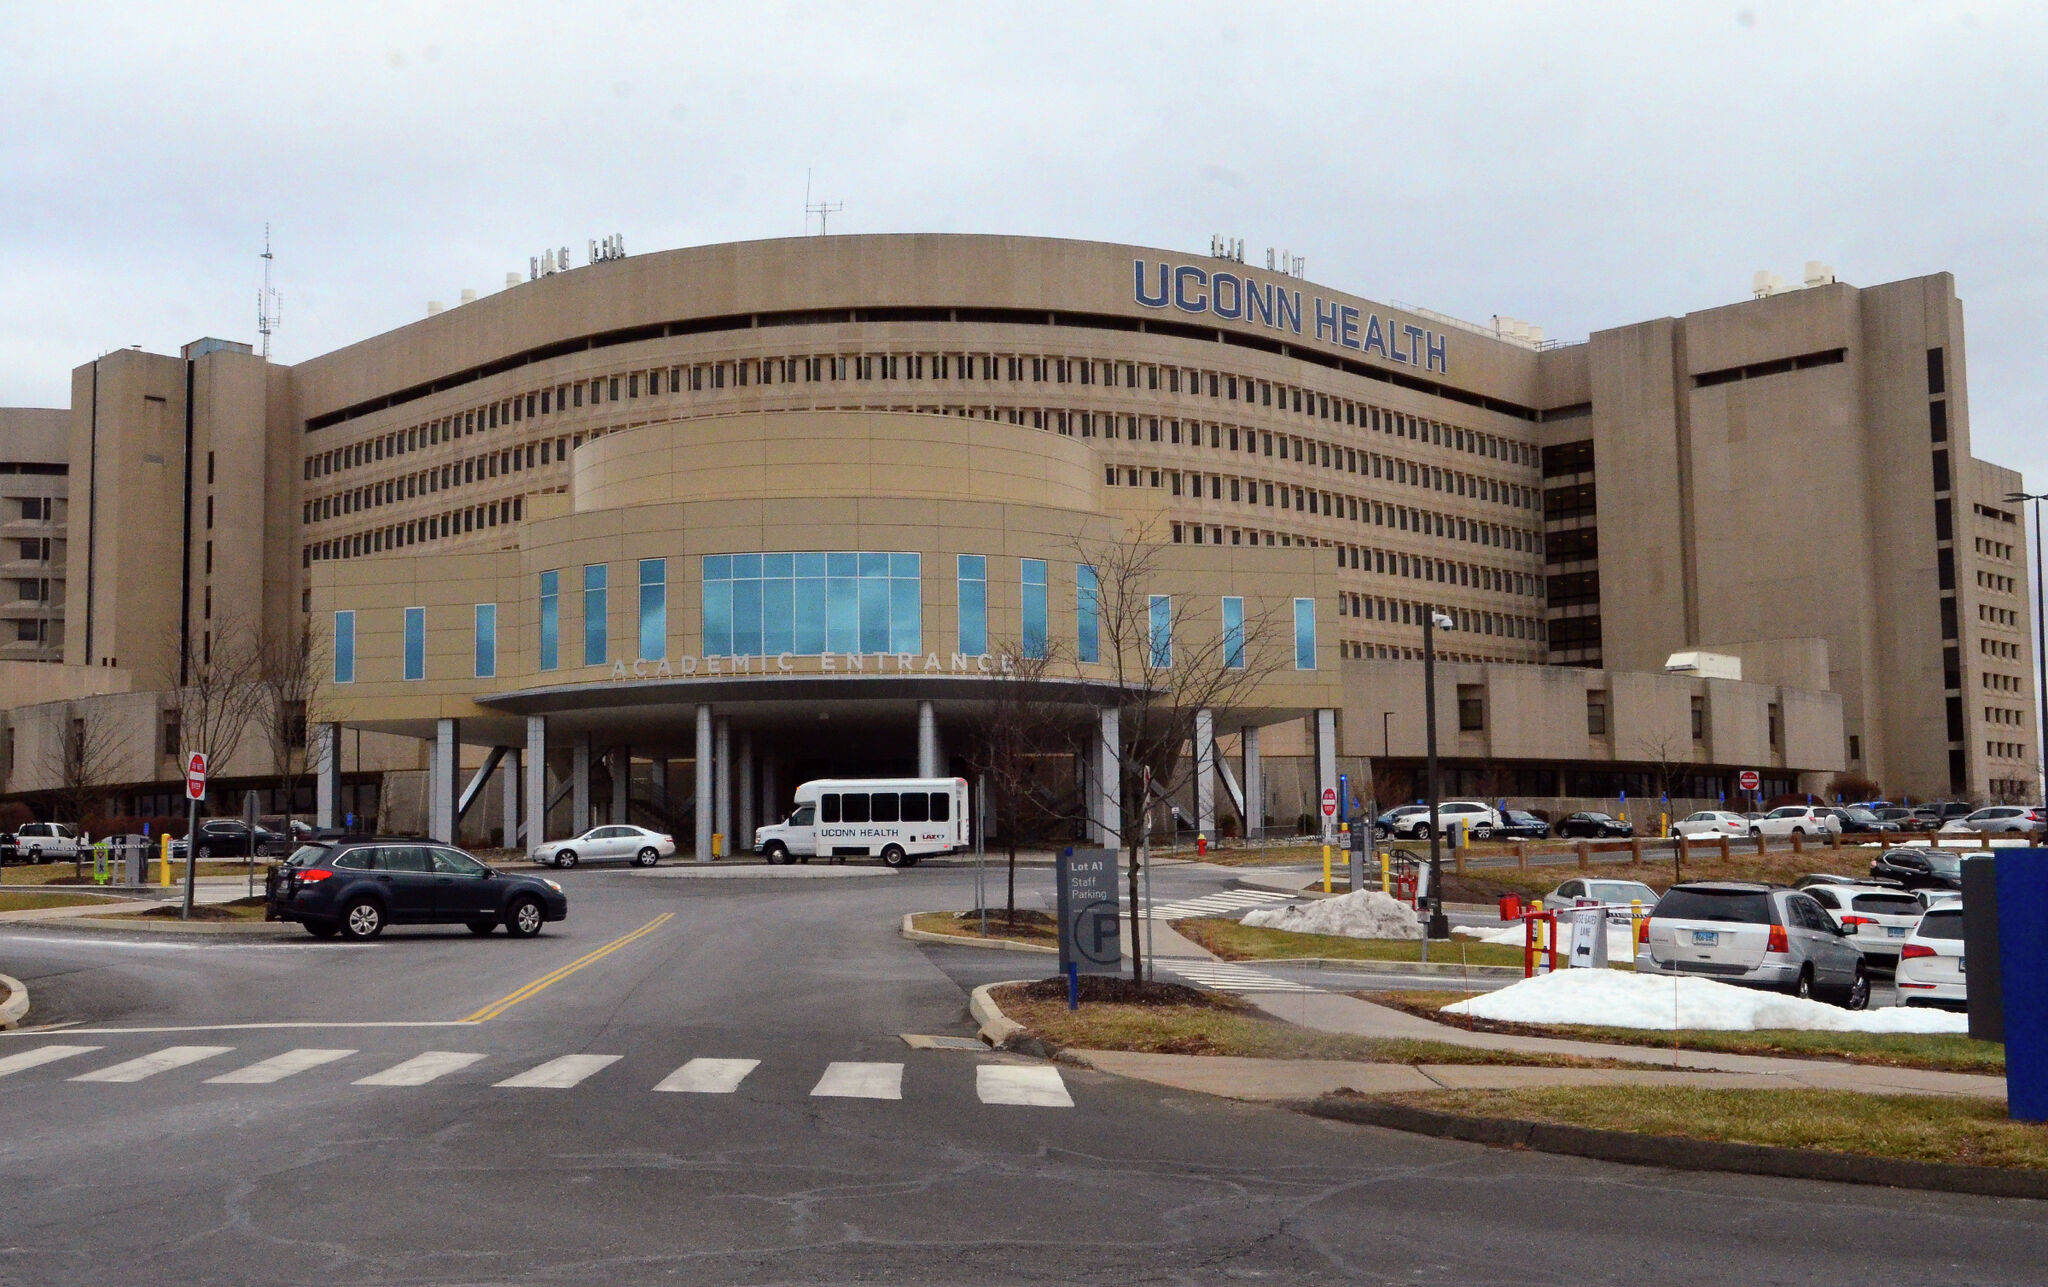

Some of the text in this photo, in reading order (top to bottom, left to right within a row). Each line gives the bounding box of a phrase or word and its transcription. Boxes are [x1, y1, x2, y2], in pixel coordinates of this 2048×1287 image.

[1133, 258, 1447, 375] UCONN HEALTH
[612, 651, 1014, 677] ACADEMIC ENTRANCE
[821, 828, 899, 837] UCONN HEALTH
[1071, 862, 1103, 871] Lot A1
[1071, 877, 1096, 887] Staff
[1071, 889, 1107, 900] Parking
[1093, 914, 1120, 953] P
